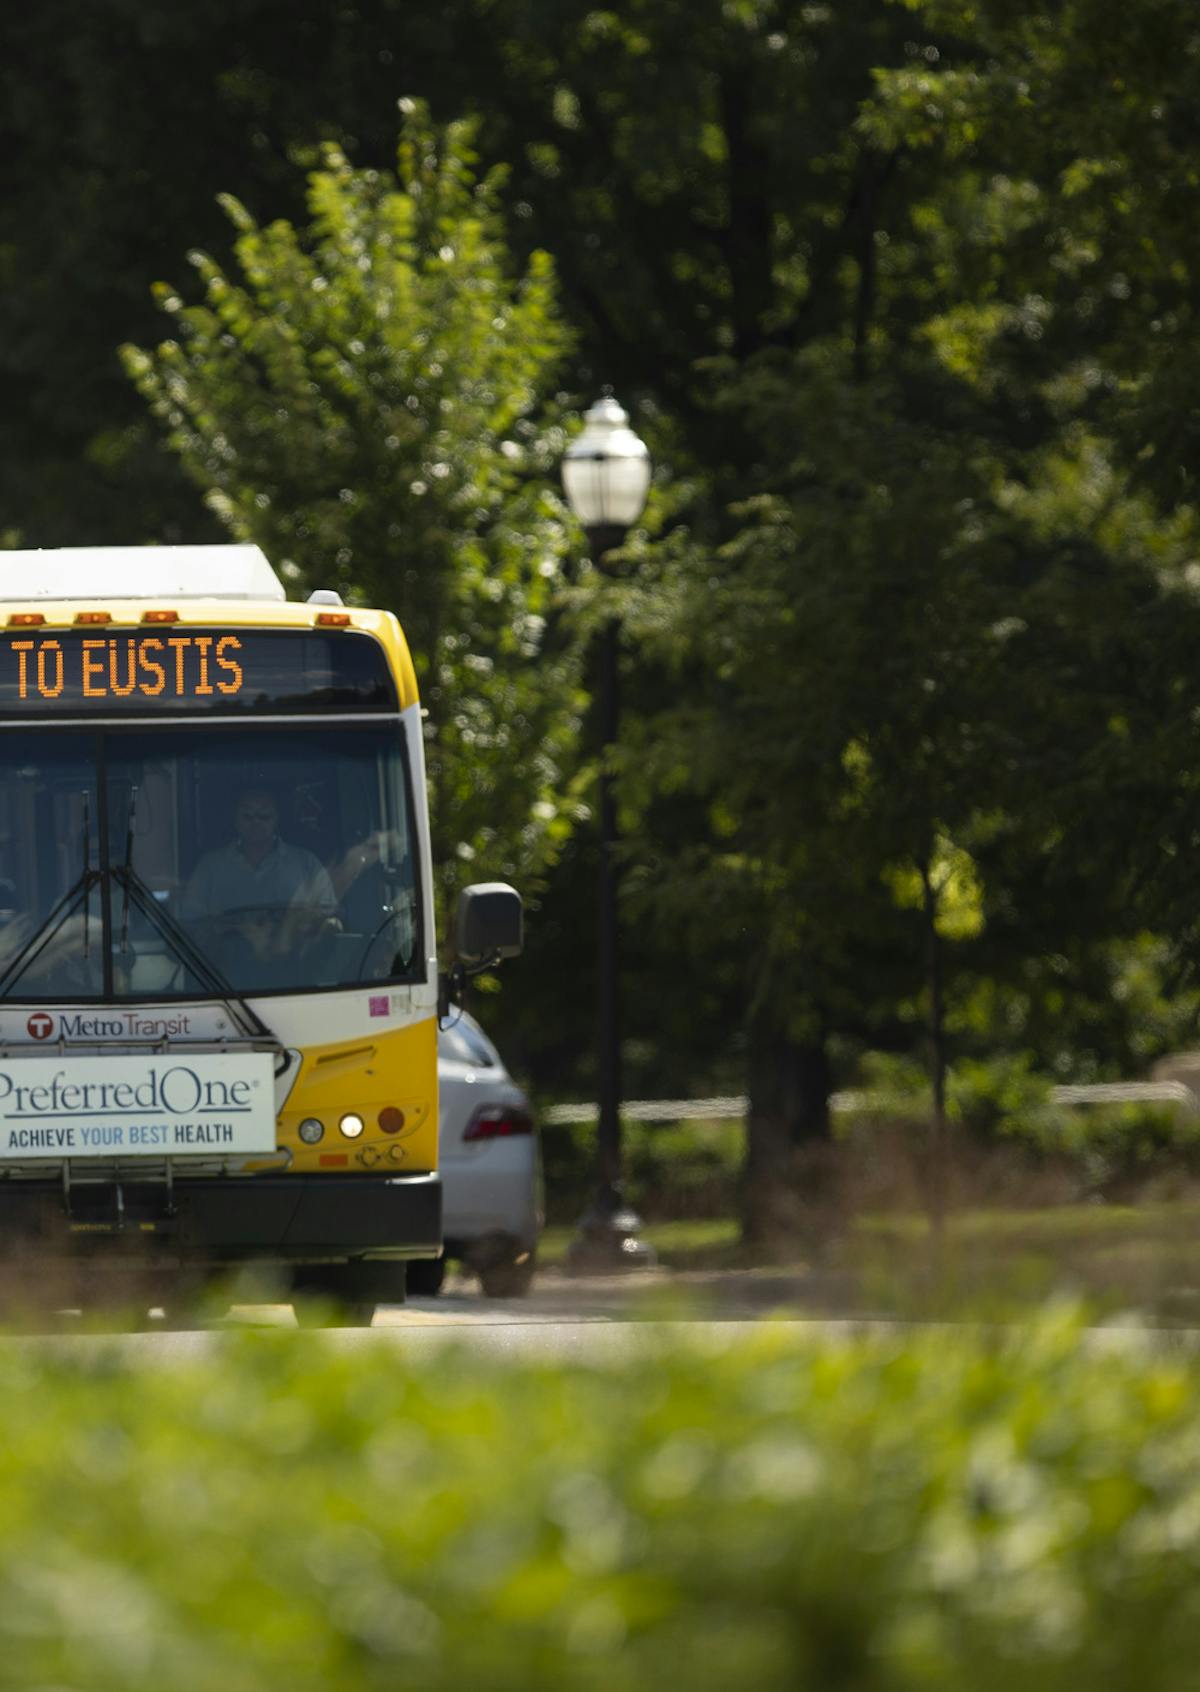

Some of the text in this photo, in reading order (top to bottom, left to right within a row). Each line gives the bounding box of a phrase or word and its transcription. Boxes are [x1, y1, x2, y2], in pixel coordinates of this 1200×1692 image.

[11, 639, 64, 698] TO
[82, 636, 243, 697] EUSTIS
[8, 1124, 233, 1149] ACHIEVE YOUR BEST HEALTH
